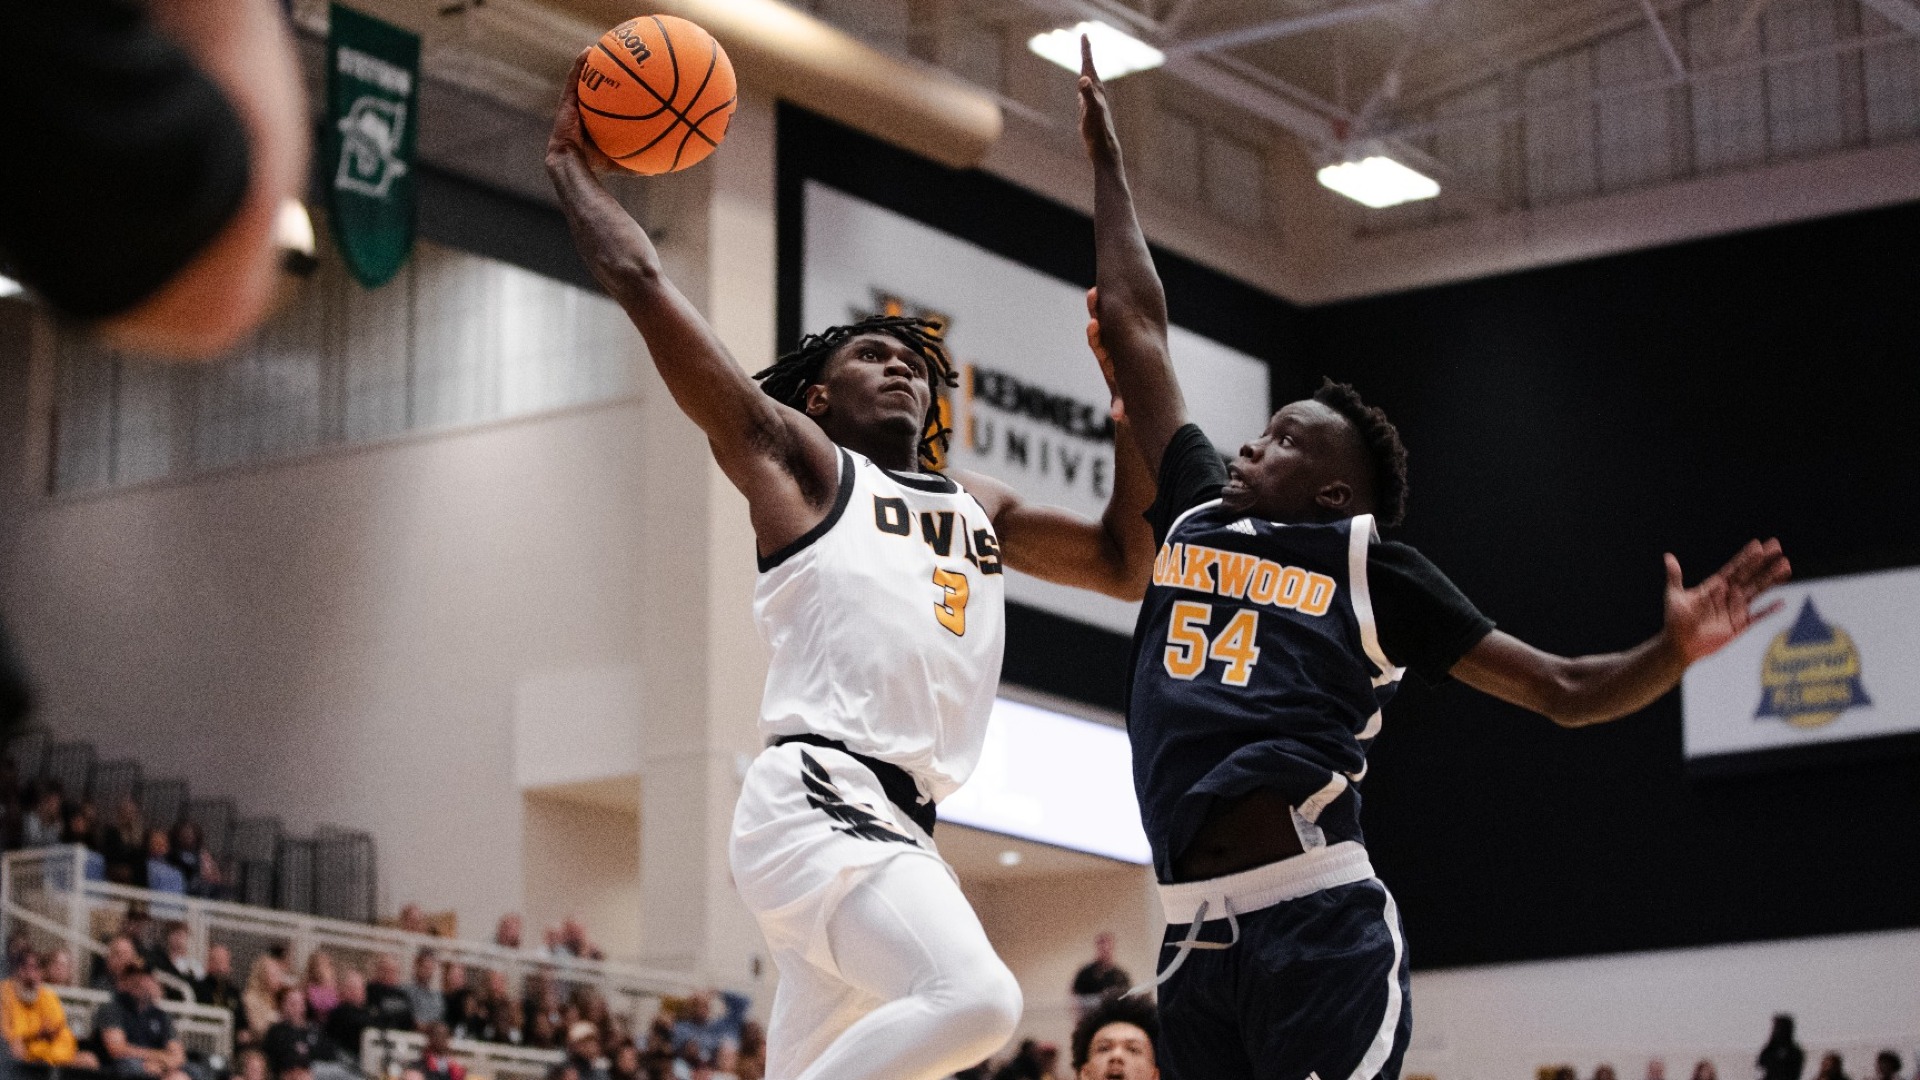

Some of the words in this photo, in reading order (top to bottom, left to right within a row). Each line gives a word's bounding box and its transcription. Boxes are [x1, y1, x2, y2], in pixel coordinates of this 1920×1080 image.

[580, 62, 605, 92] VO
[973, 365, 1114, 442] KENNESA
[973, 417, 1109, 499] UNIVE
[873, 494, 1003, 576] OWLS
[932, 566, 970, 637] 3
[1153, 542, 1337, 617] OAKWOOD
[1163, 600, 1260, 687] 54
